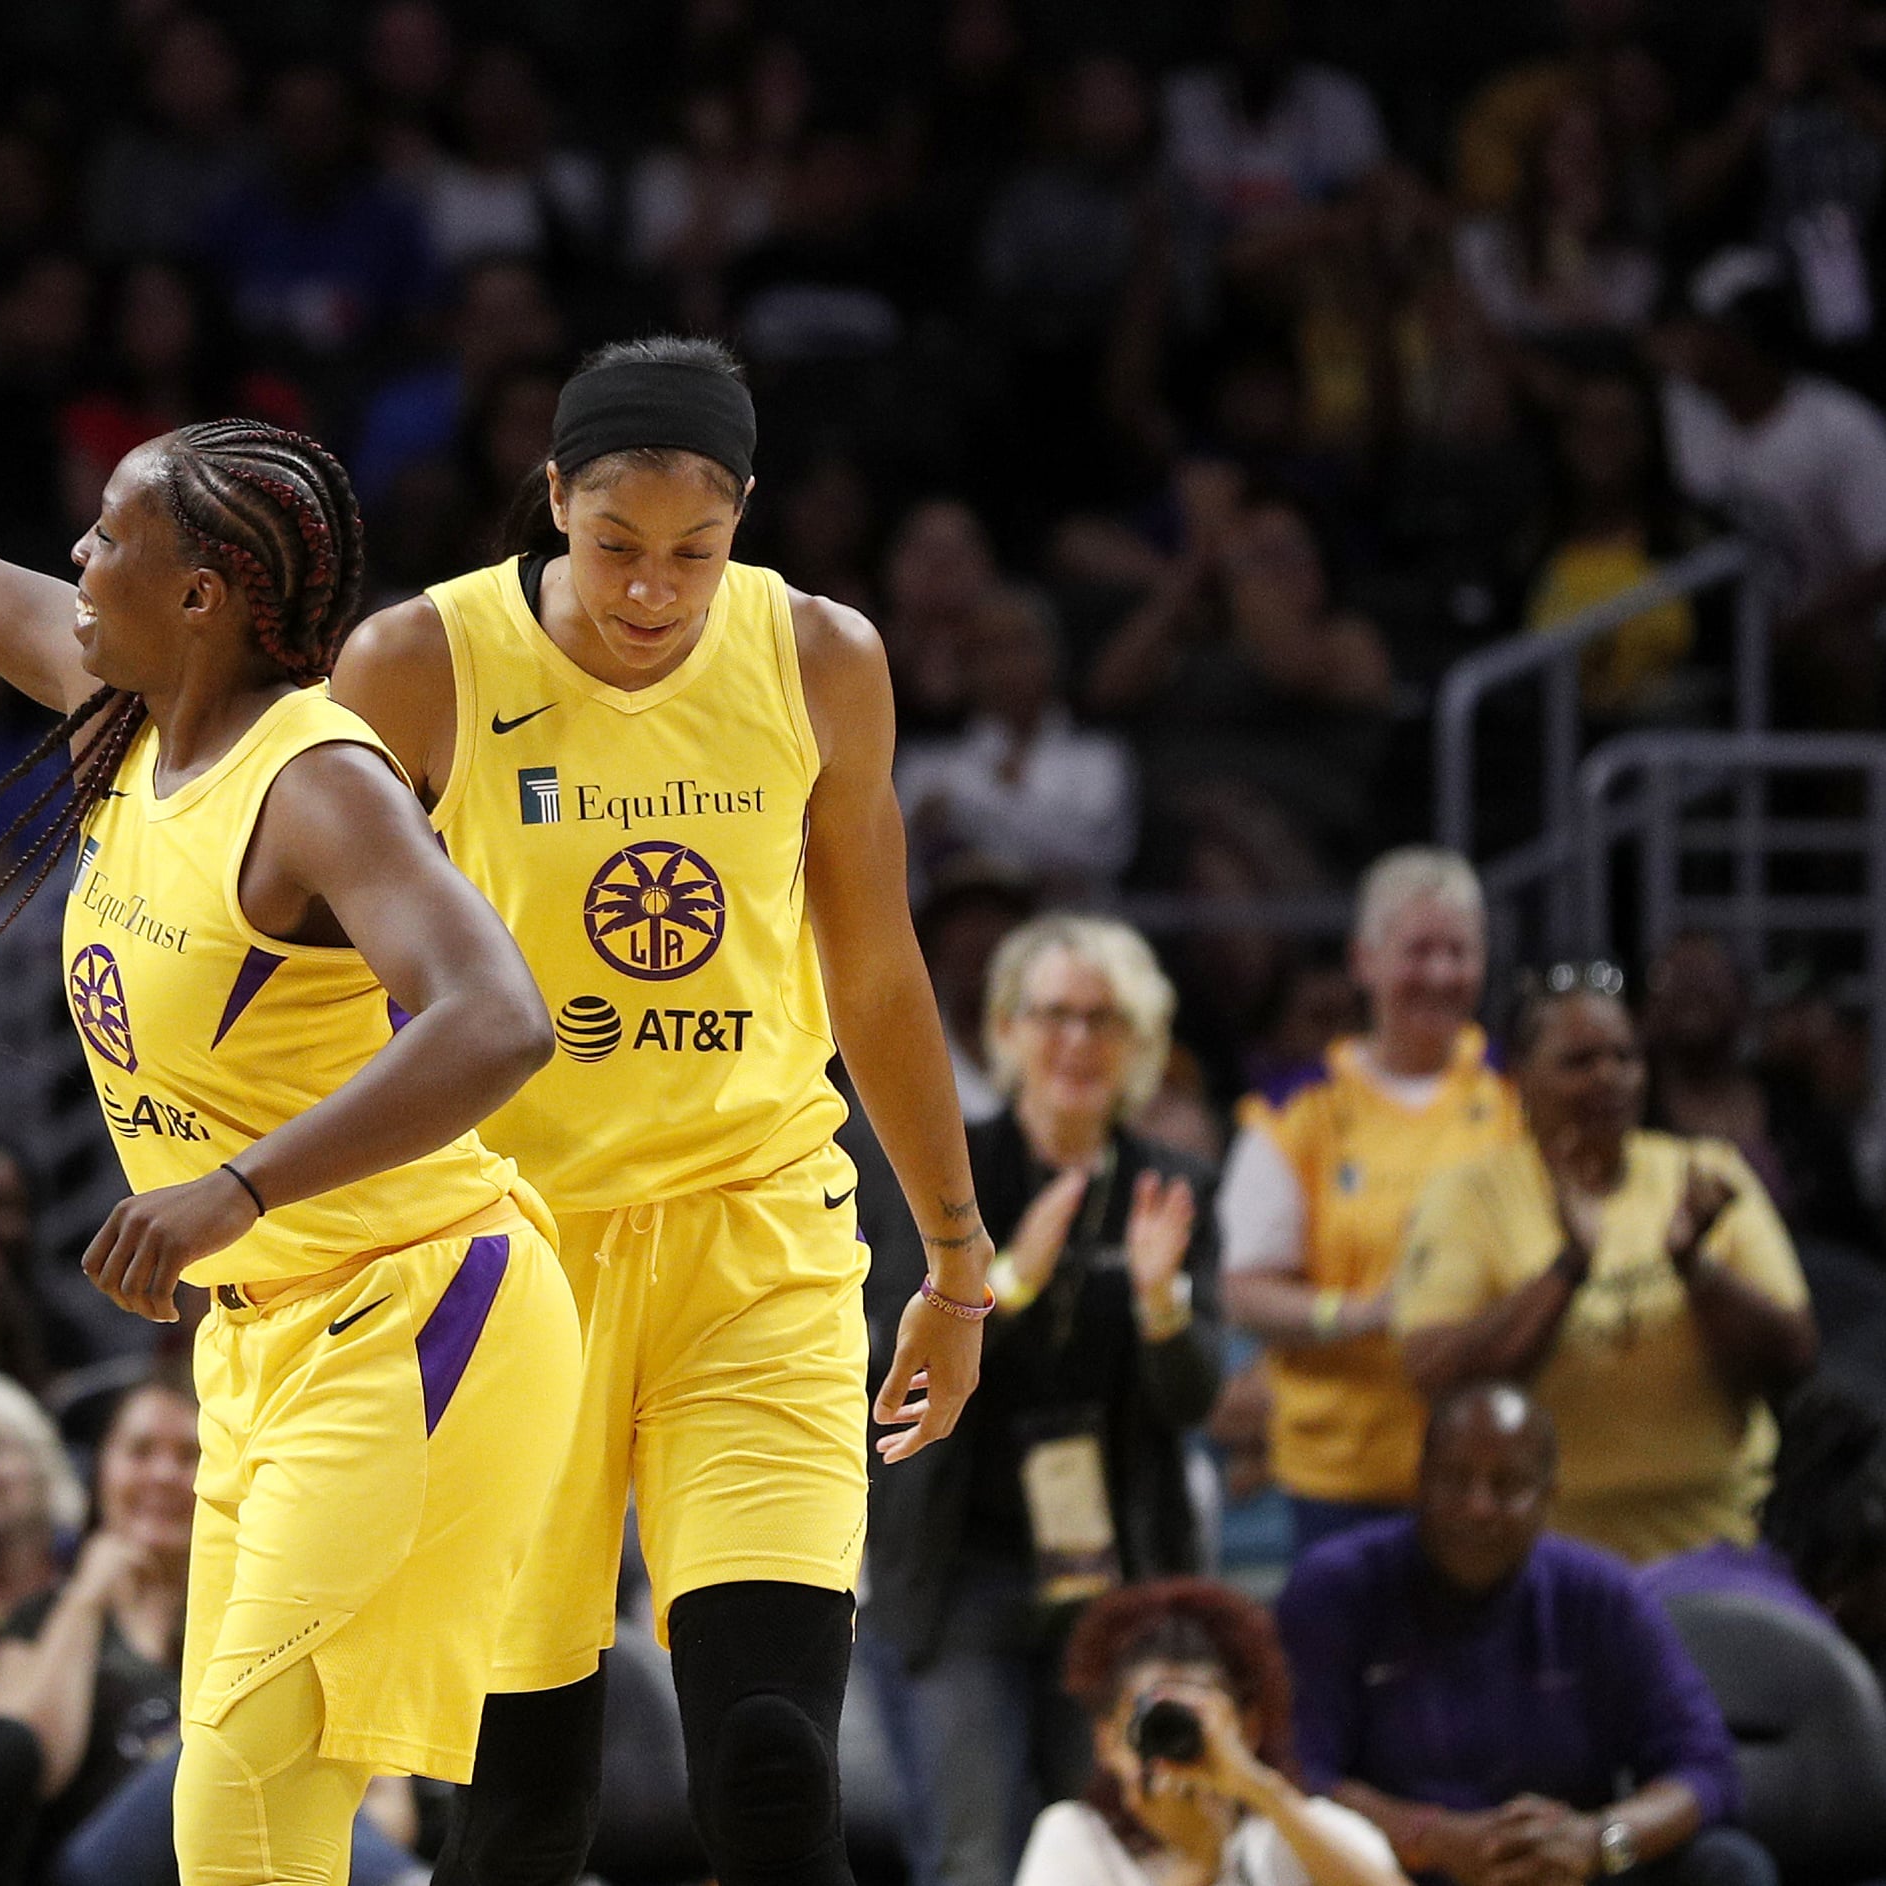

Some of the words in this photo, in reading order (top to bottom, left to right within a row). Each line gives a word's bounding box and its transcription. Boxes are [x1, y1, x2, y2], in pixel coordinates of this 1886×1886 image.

[575, 780, 767, 830] EquiTrust
[82, 871, 191, 954] EquTrust
[632, 1008, 753, 1052] AT&T
[230, 1666, 253, 1688] LOS
[260, 1619, 321, 1665] ANGELES
